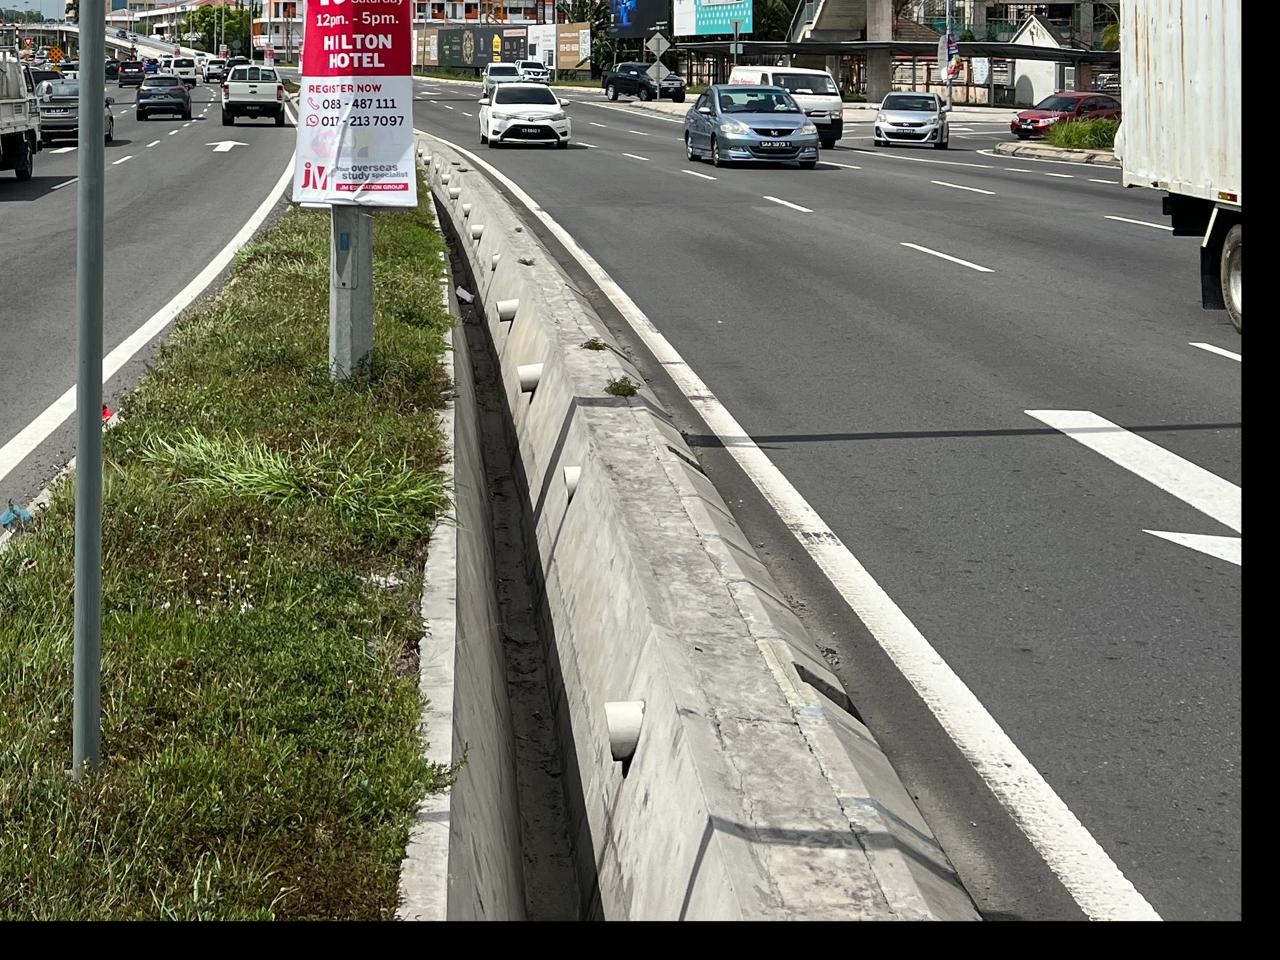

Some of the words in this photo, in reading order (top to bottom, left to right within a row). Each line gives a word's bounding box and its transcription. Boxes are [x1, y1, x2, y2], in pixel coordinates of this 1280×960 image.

[316, 13, 349, 28] 12pm.
[362, 12, 399, 26] 5pm.
[323, 34, 393, 50] HILTON
[329, 53, 385, 69] HOTEL
[357, 84, 382, 92] NOW
[352, 98, 373, 109] 487
[375, 98, 397, 109] 111
[350, 116, 370, 126] 213
[373, 116, 404, 126] 7097
[351, 164, 398, 172] overseas
[342, 171, 370, 180] study
